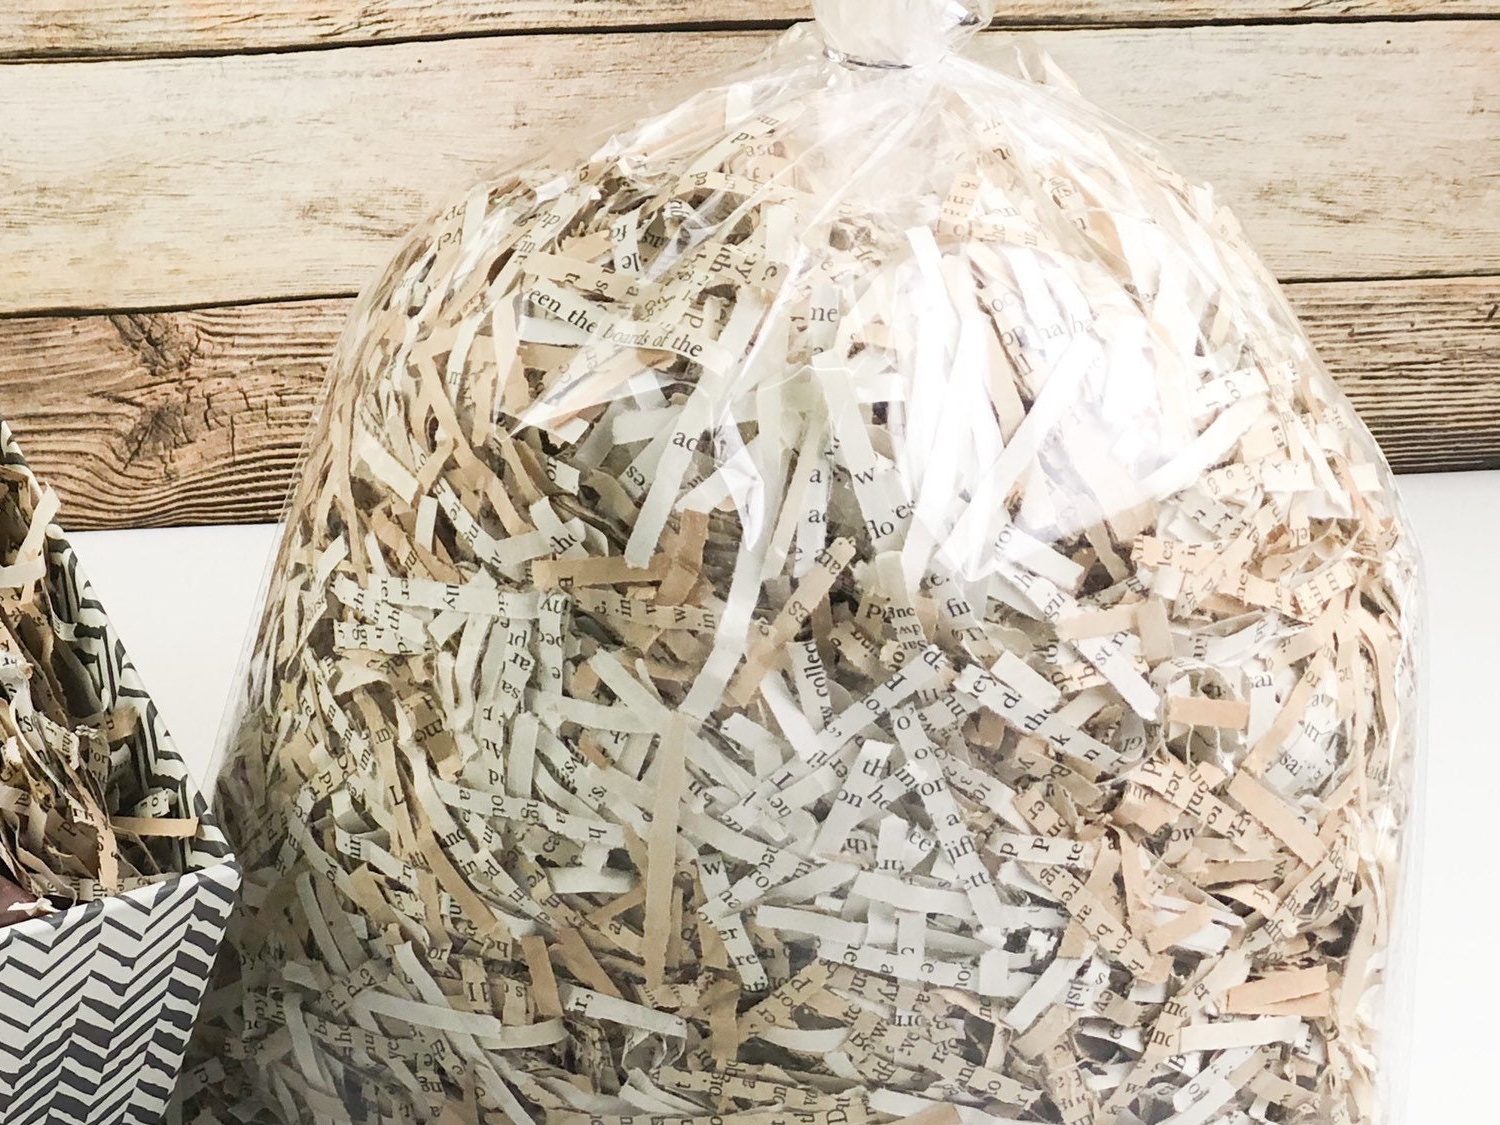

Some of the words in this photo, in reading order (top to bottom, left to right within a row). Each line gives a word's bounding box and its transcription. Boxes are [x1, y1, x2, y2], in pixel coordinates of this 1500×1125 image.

[566, 309, 598, 335] the
[651, 331, 672, 349] of
[671, 336, 703, 357] the
